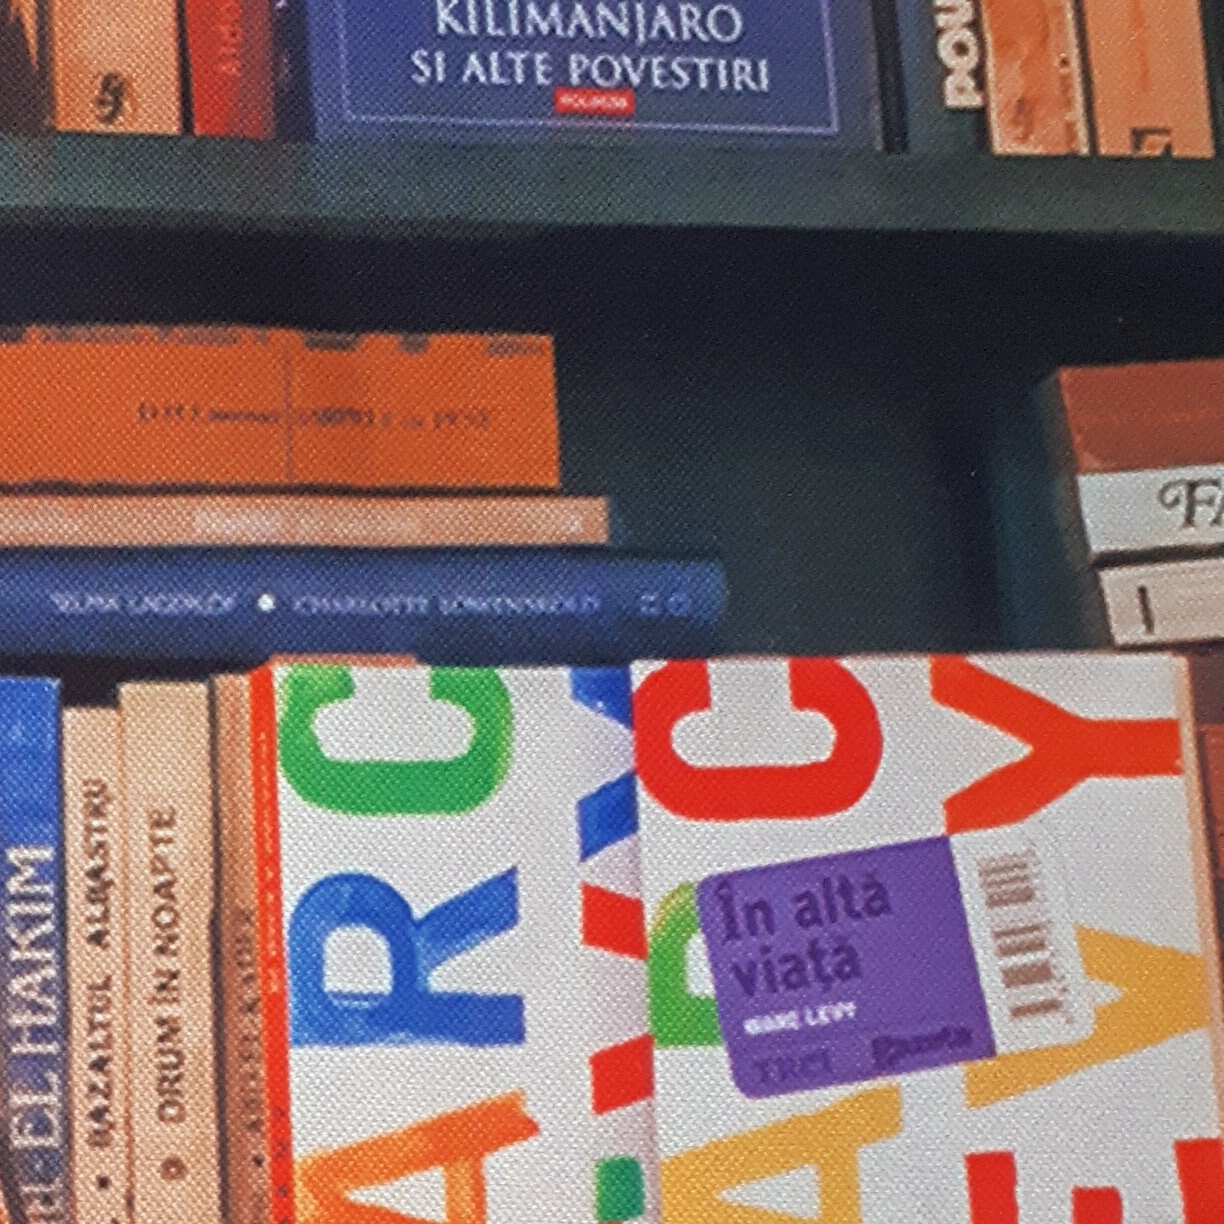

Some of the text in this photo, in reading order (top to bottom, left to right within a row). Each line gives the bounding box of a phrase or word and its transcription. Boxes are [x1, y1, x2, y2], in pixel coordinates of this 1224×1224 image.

[436, 0, 743, 41] KILIMANJARO
[463, 55, 553, 84] ALTE
[568, 56, 771, 93] POVESTIRI
[149, 808, 180, 958] NOAPTE
[713, 877, 776, 944] În
[4, 845, 59, 1056] HAKIM
[8, 1071, 60, 1149] EL
